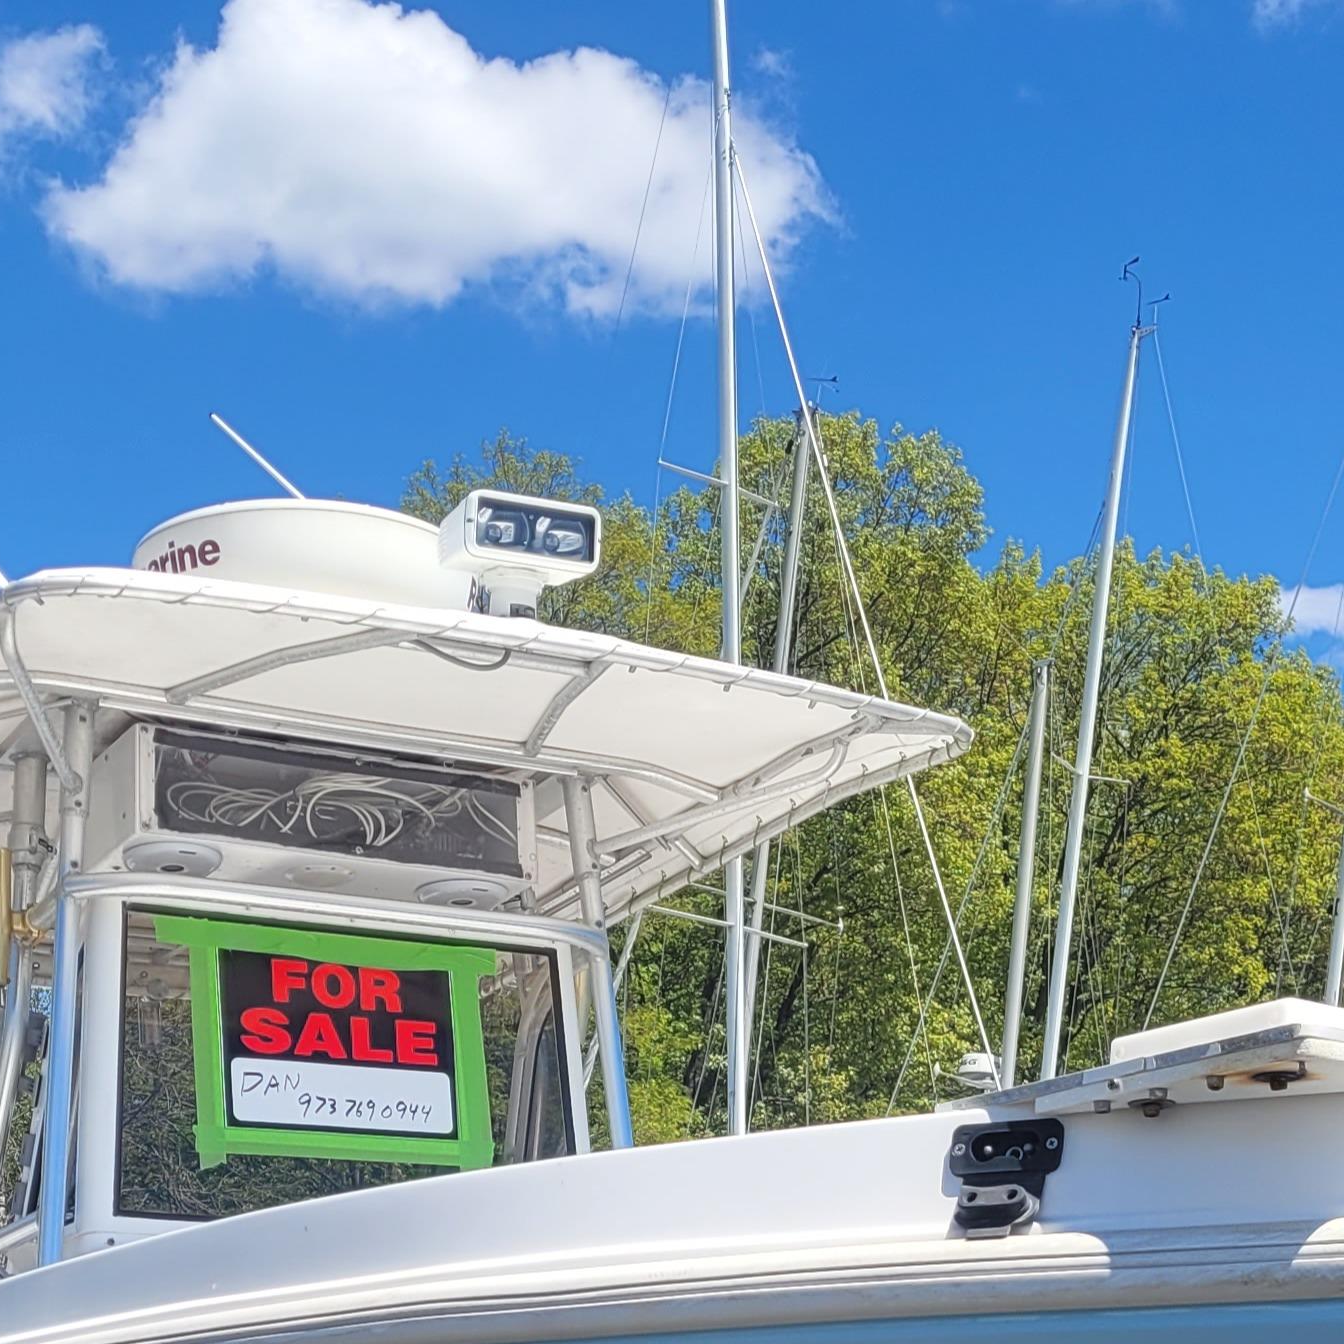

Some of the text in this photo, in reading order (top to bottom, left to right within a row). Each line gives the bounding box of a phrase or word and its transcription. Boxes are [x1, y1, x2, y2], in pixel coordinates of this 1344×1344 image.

[144, 539, 221, 574] arine
[270, 958, 402, 1013] FOR
[240, 1007, 439, 1066] SALE
[241, 1072, 301, 1096] DAN
